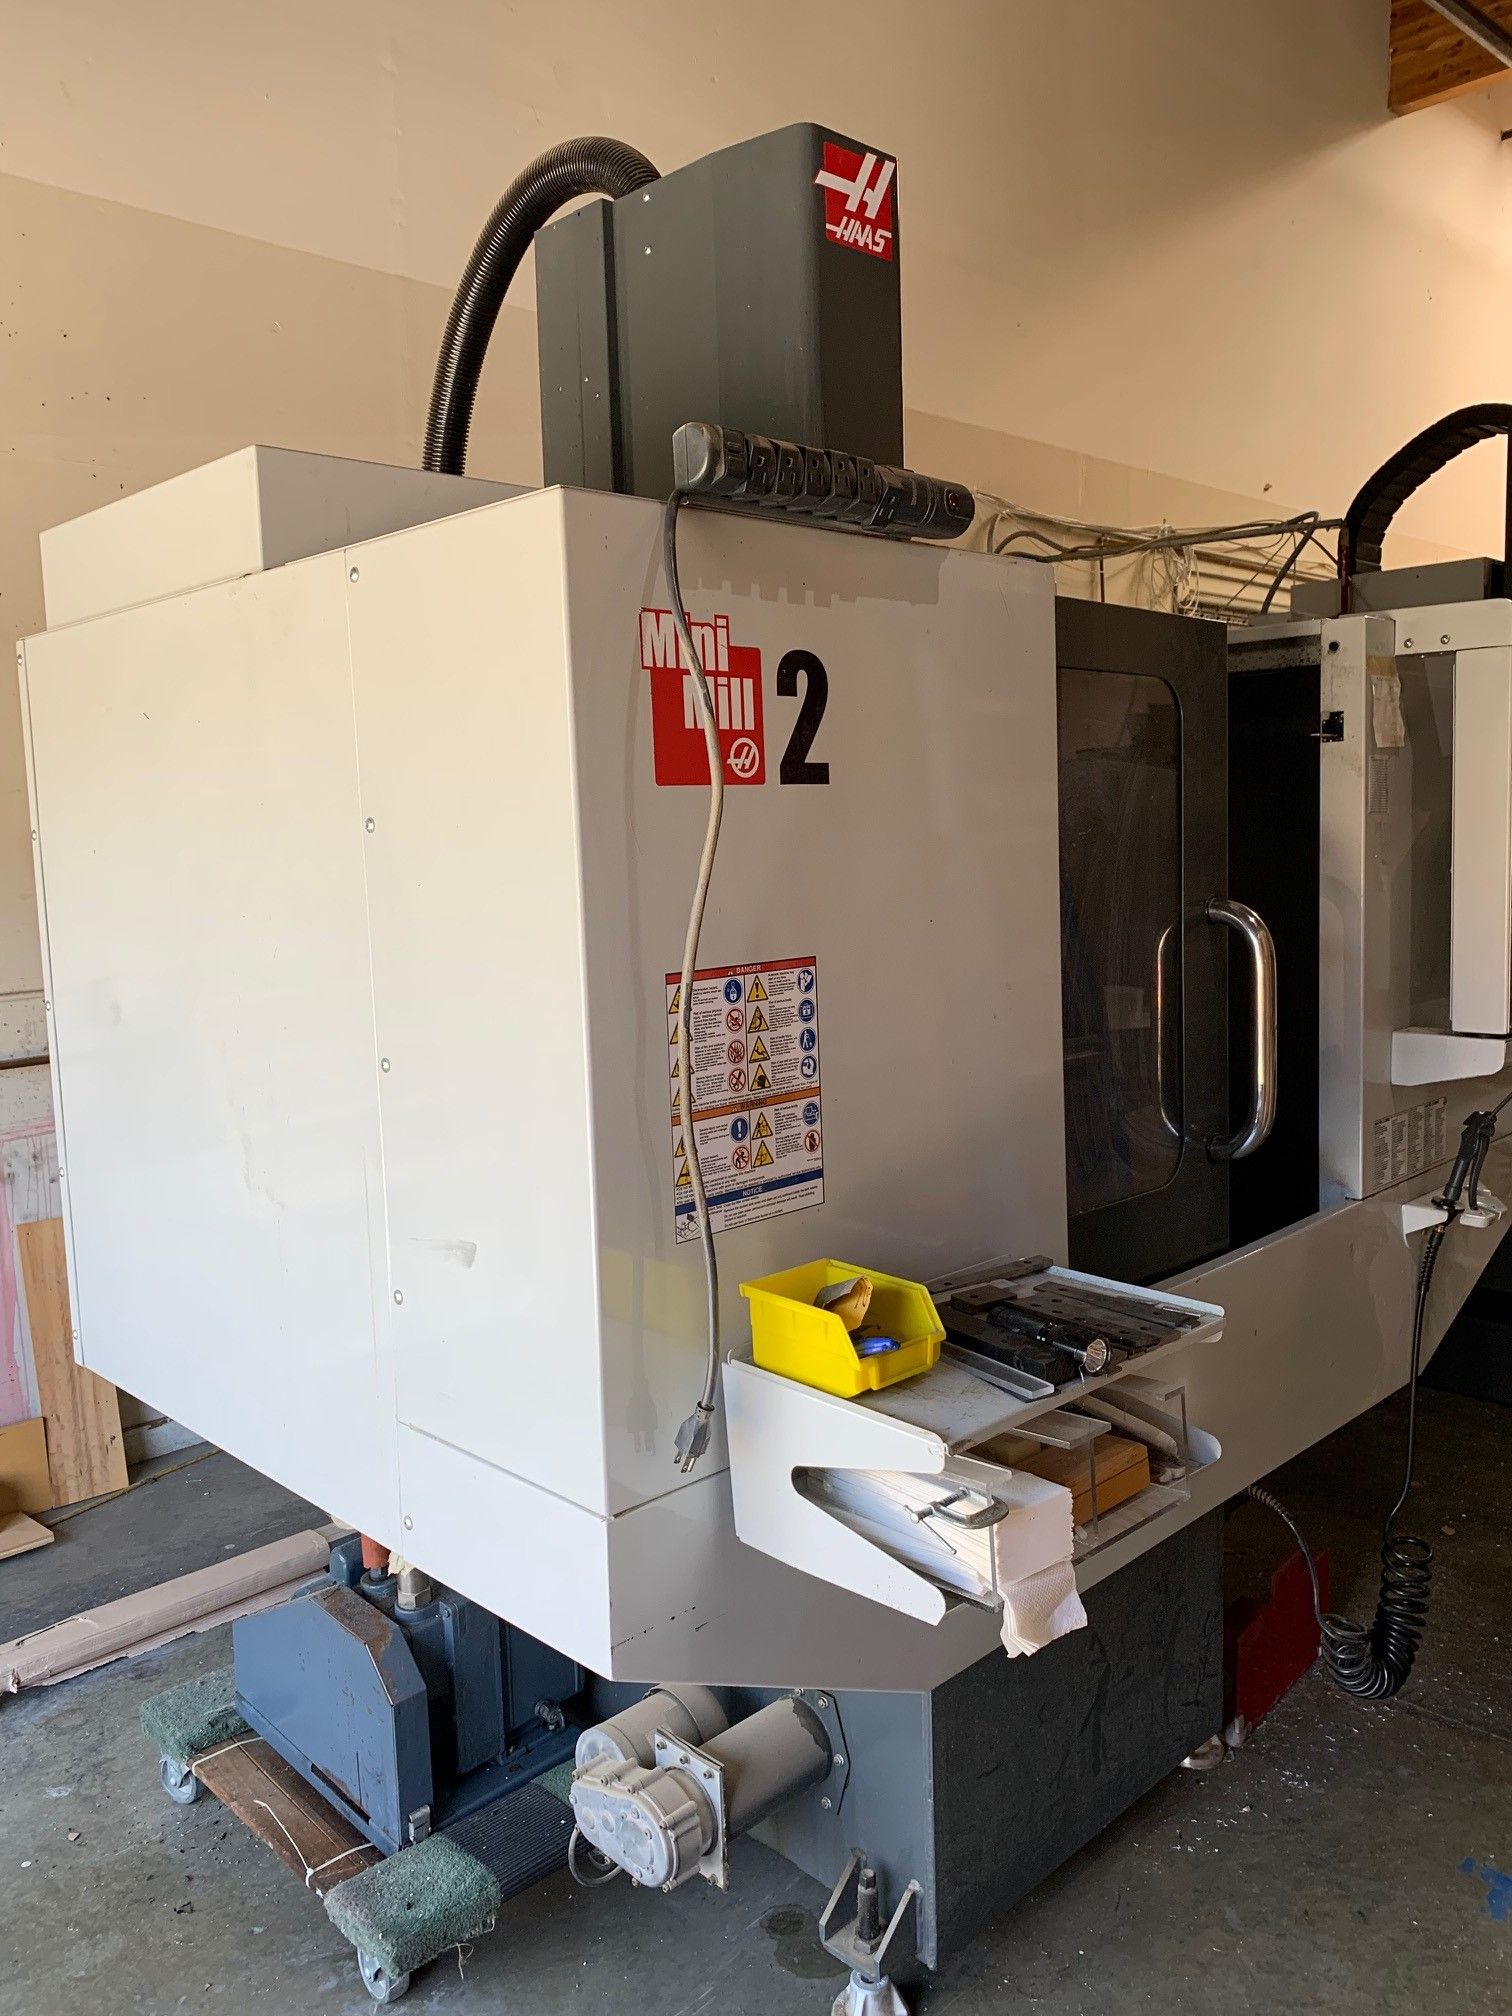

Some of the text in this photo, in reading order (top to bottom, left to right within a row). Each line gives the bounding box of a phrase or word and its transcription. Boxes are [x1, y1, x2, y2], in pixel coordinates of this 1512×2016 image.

[826, 216, 892, 253] HAAS
[776, 649, 830, 785] 2
[736, 964, 762, 974] DANGER
[742, 1186, 763, 1197] NOTICE
